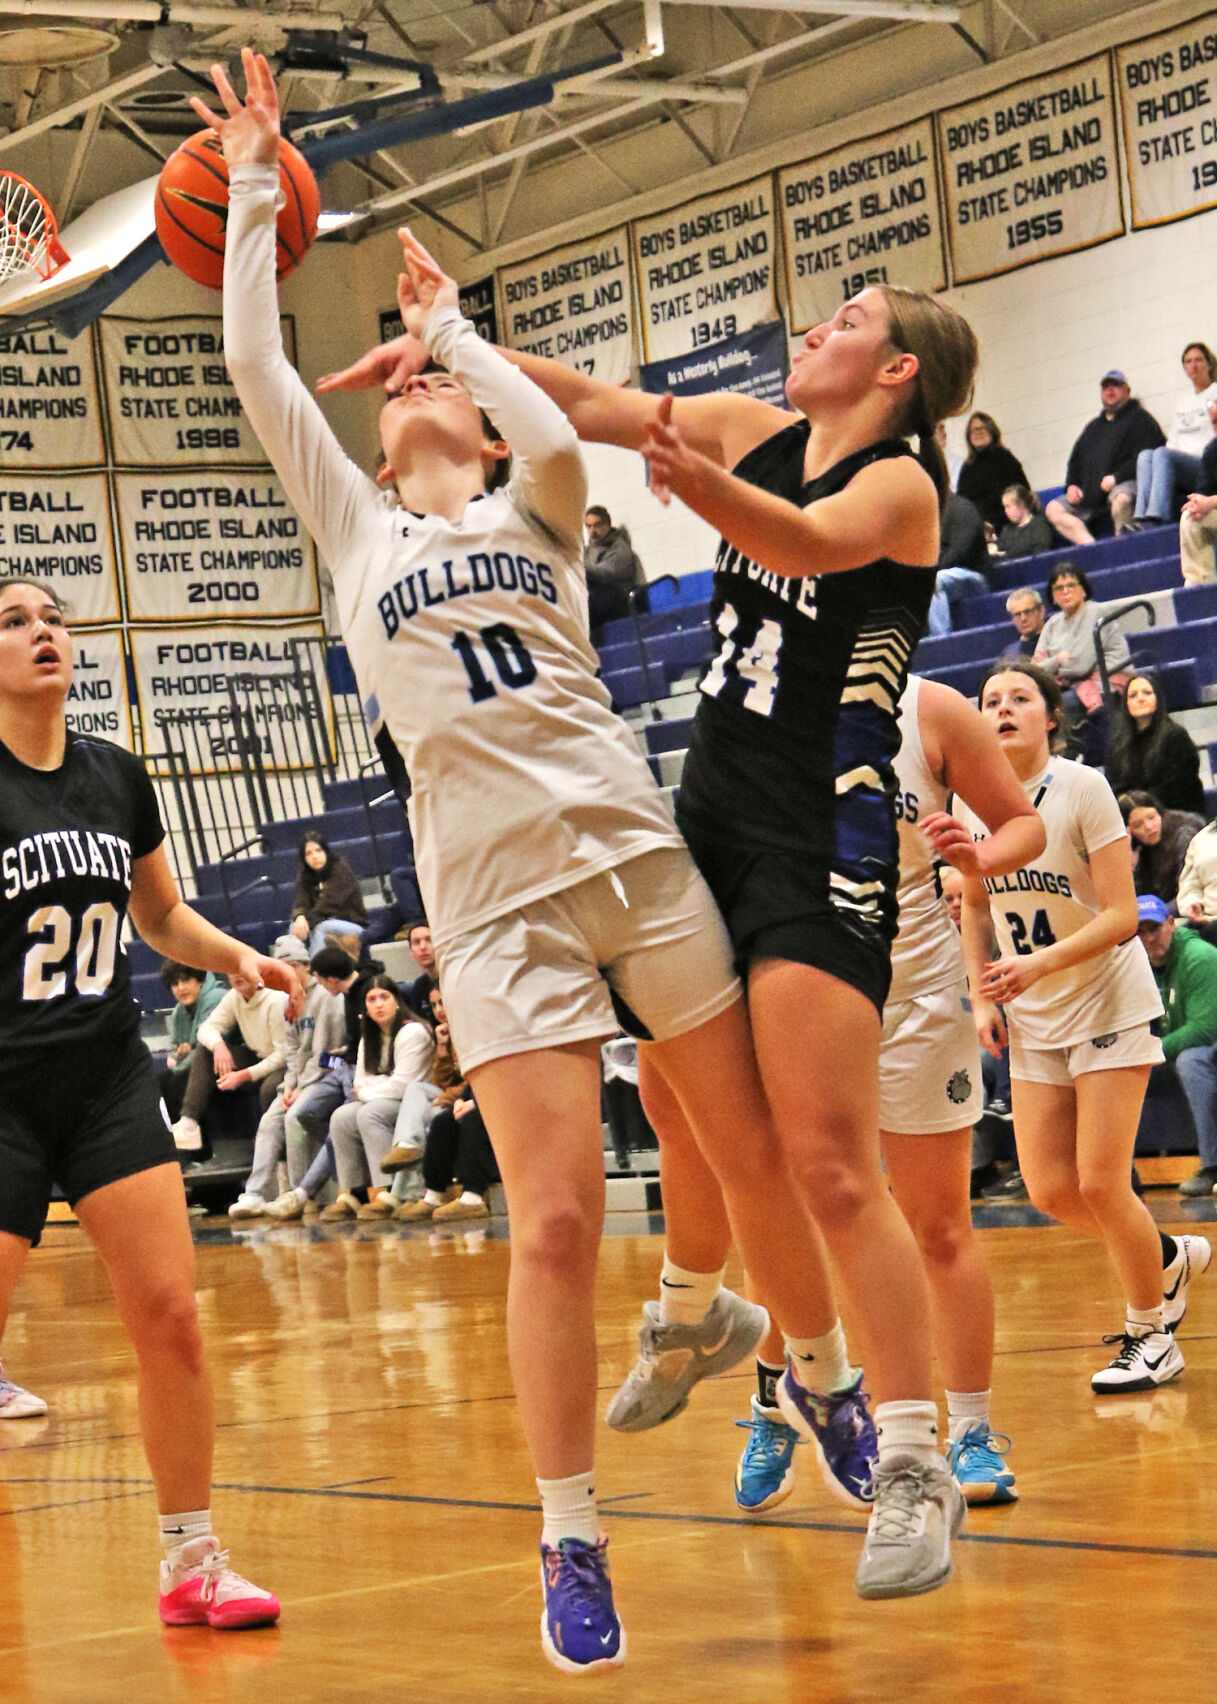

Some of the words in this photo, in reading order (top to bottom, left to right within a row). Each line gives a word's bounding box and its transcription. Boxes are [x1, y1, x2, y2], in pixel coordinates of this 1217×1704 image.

[1126, 52, 1174, 89] BOYS
[947, 117, 990, 152] BOYS
[995, 78, 1105, 136] BASKETBALL
[1137, 78, 1211, 126] RHODE
[956, 142, 1023, 188] RHODE
[1029, 117, 1101, 162] ISLAND
[1138, 126, 1195, 165] STATE
[785, 175, 824, 208] BOYS
[828, 140, 928, 194] BASKETBALL
[958, 188, 1010, 226] STATE
[1013, 156, 1108, 207] CHAMPIONS
[640, 228, 675, 257] BOYS
[679, 195, 770, 245] BASKETBALL
[793, 201, 854, 242] RHODE
[859, 176, 926, 220] ISLAND
[1006, 210, 1064, 250] 1955
[648, 252, 704, 290] RHODE
[708, 230, 768, 270] ISLAND
[795, 243, 842, 277] STATE
[847, 213, 931, 261] CHAMPIONS
[506, 277, 538, 304] BOYS
[541, 246, 624, 292] BASKETBALL
[650, 292, 692, 325] STATE
[696, 265, 770, 311] CHAMPIONS
[513, 299, 564, 335] RHODE
[568, 280, 623, 315] ISLAND
[515, 337, 554, 358] TATE
[556, 313, 628, 354] CHAMPIONS
[120, 365, 194, 387] RHODE
[121, 398, 179, 418] STATE
[176, 428, 240, 450] 1996
[141, 487, 286, 509] FOOTBALL
[14, 522, 97, 544] ISLAND
[135, 519, 211, 541] RHODE
[219, 517, 297, 539] ISLAND
[0, 554, 103, 577] CHAMPIONS
[136, 552, 194, 573] STATE
[200, 548, 303, 571] CHAMPIONS
[187, 581, 259, 603] 2000
[377, 552, 558, 640] BULLDOGS
[157, 641, 294, 664] FOOTBALL
[451, 622, 538, 704] 10
[699, 602, 783, 717] 14
[151, 673, 228, 696] RHODE
[2, 830, 132, 900] SCITUATE
[22, 901, 119, 1000] 20
[1005, 908, 1057, 955] 24
